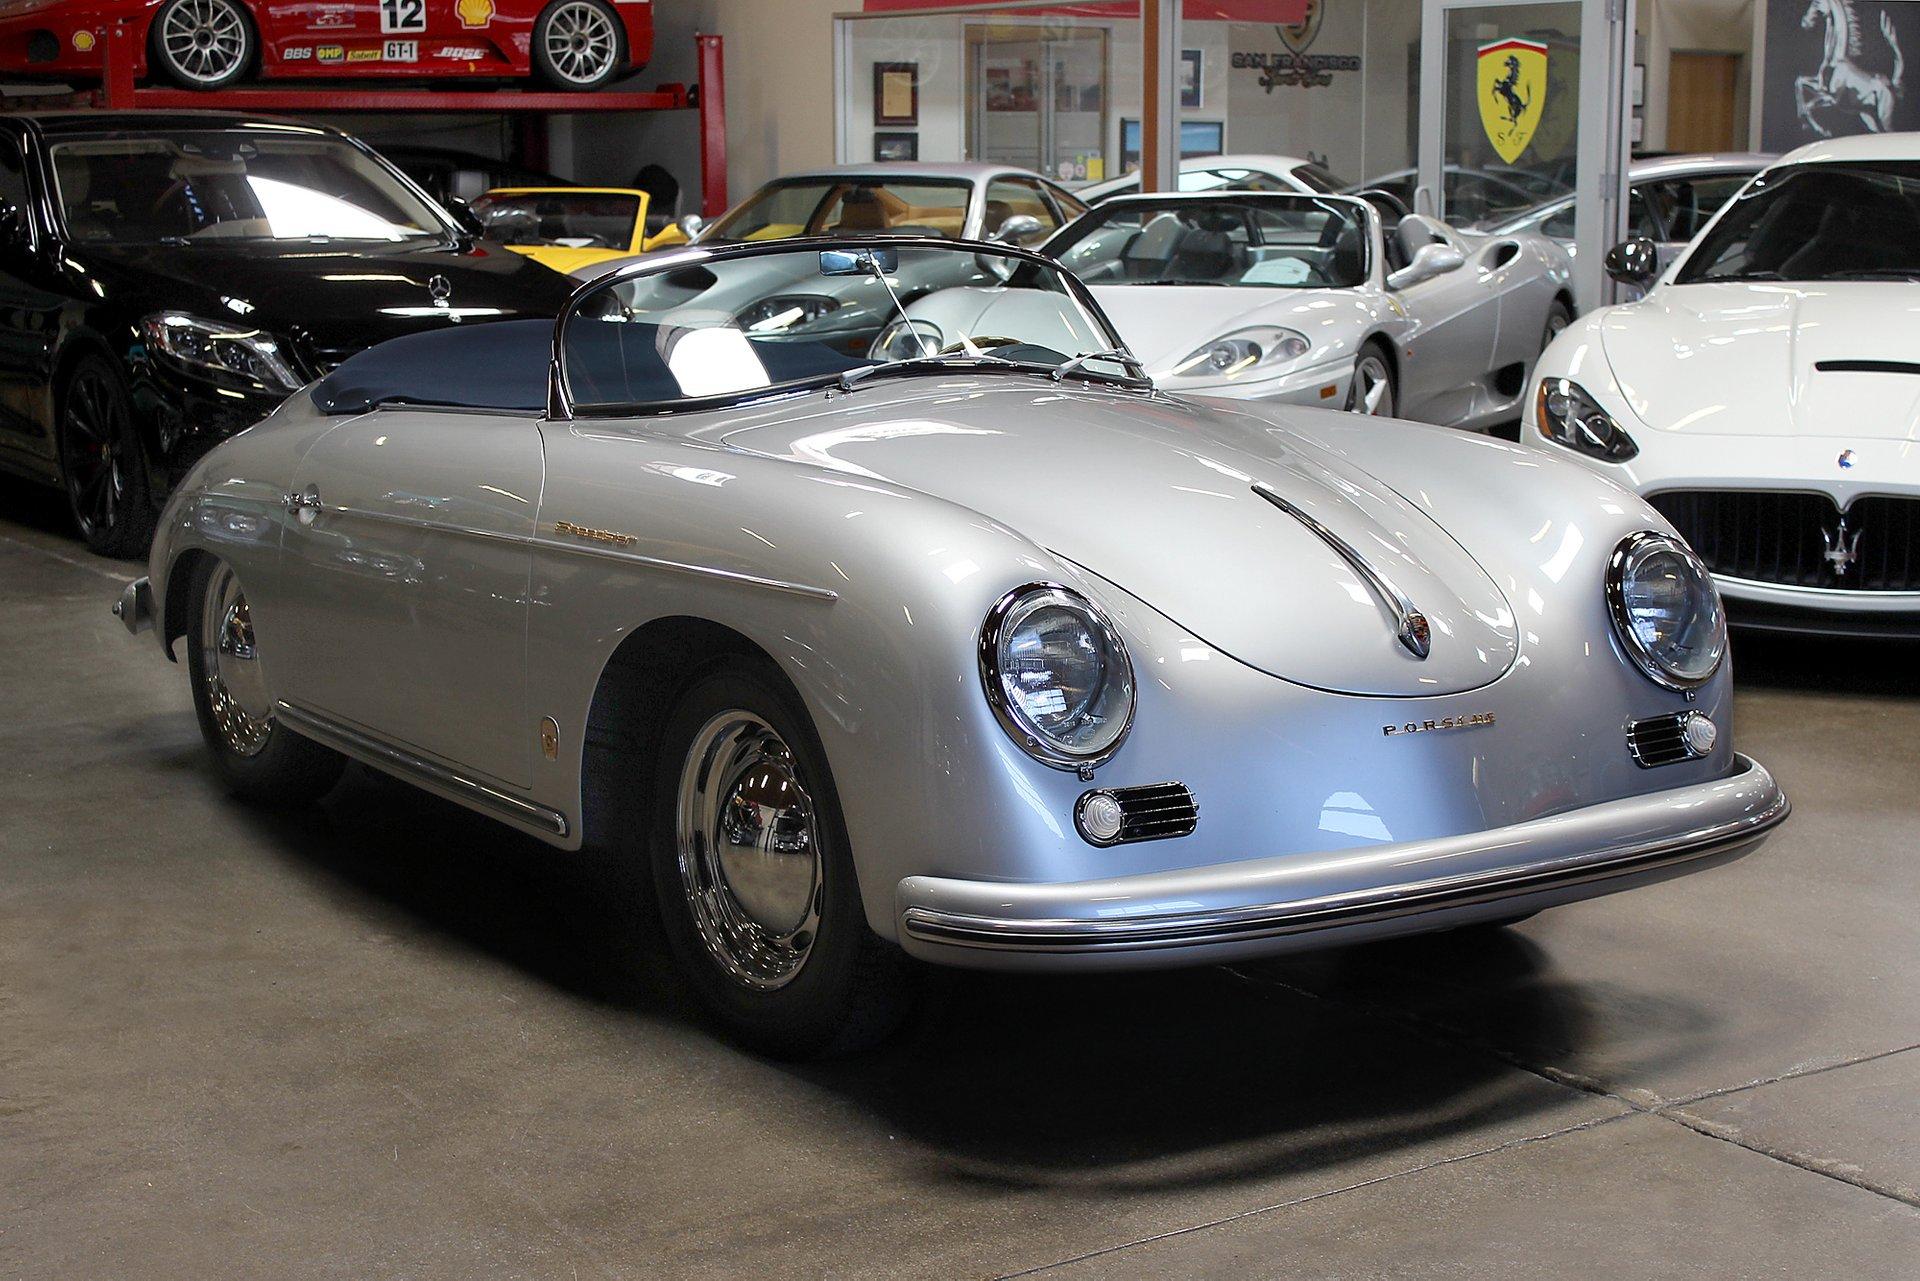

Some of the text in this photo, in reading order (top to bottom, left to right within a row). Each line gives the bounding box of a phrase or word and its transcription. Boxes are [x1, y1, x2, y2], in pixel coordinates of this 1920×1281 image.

[382, 0, 423, 28] 12
[283, 48, 312, 60] BBS
[318, 47, 342, 59] OMP
[387, 43, 413, 58] GT-1
[1231, 52, 1266, 69] SAN
